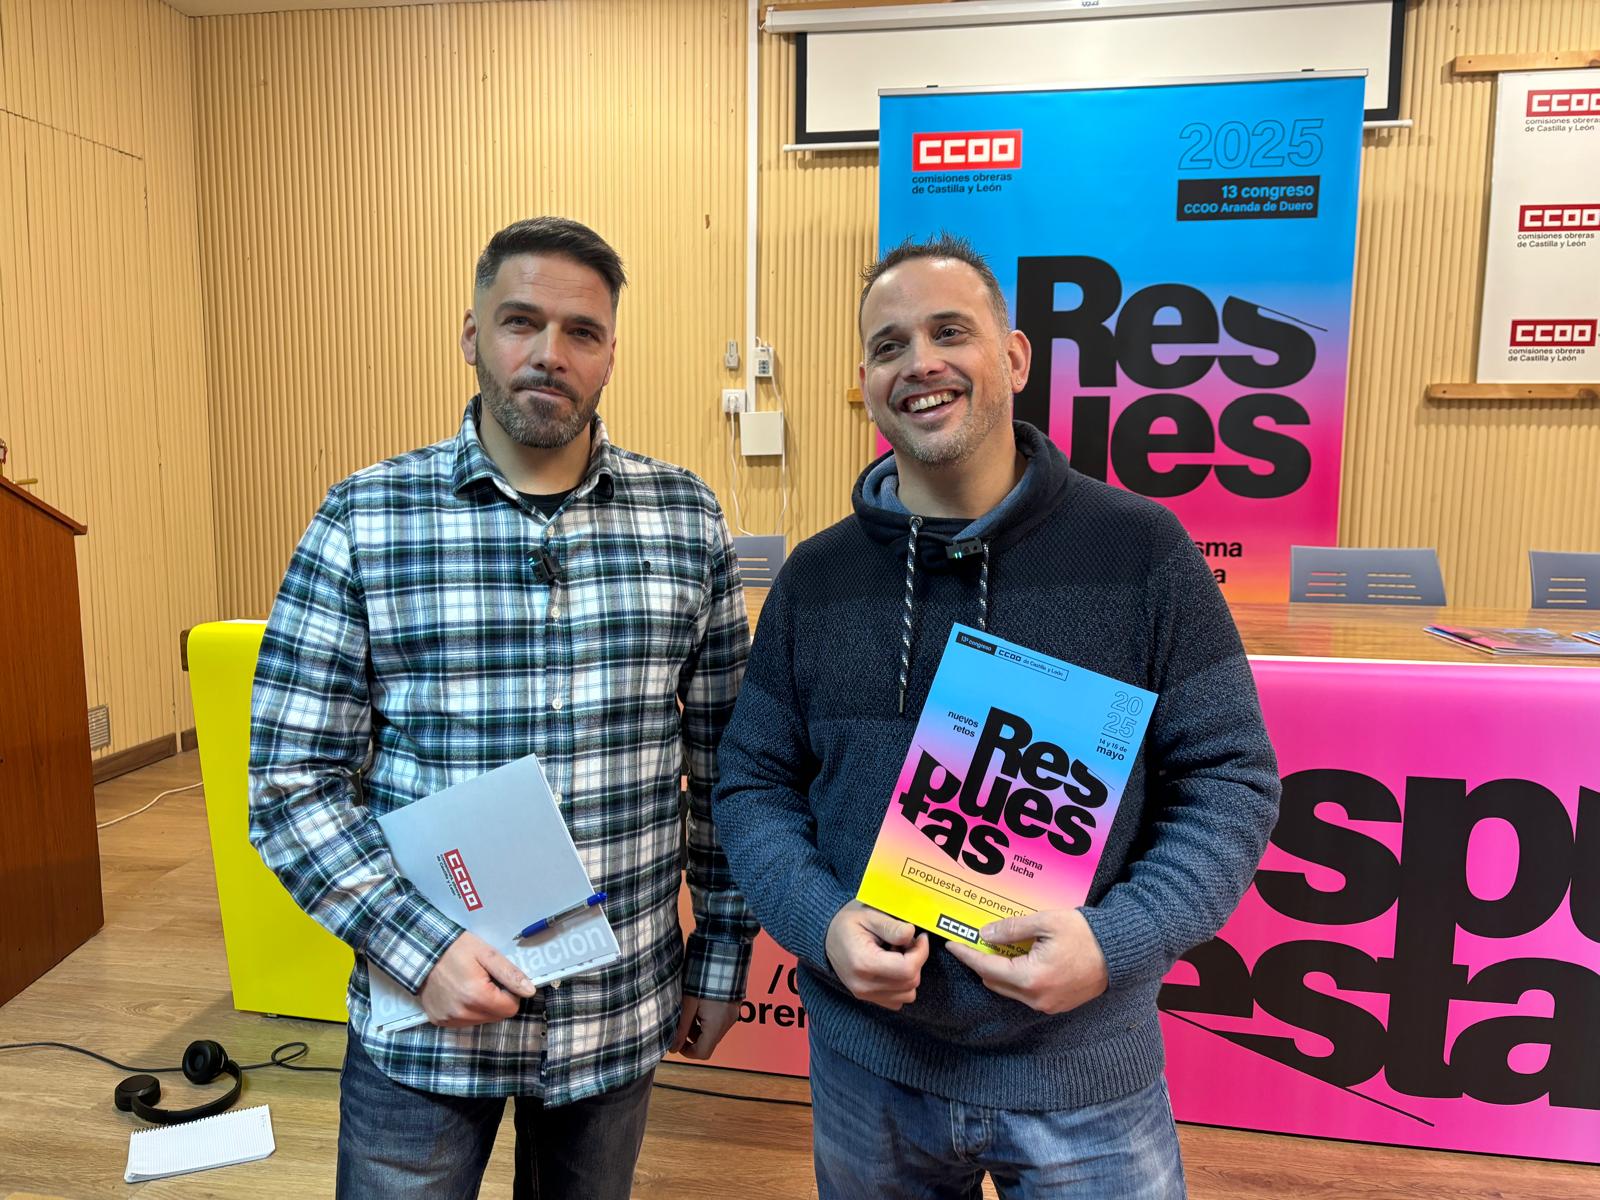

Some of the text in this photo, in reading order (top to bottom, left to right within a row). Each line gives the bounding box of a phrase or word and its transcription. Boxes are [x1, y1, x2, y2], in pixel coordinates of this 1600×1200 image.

[919, 138, 1015, 164] CCOO
[1177, 118, 1324, 170] 2025
[912, 173, 1013, 184] comisiones obreras
[911, 183, 1002, 195] de Castilla y León
[1221, 184, 1315, 200] 13 congreso
[1184, 200, 1313, 214] CCOO Aranda de Duero
[1524, 208, 1600, 227] CCOO
[1515, 324, 1592, 342] CCOO
[998, 649, 1022, 662] CCOO
[1111, 690, 1144, 716] 20
[947, 710, 979, 728] nuevos
[1102, 711, 1137, 738] 25
[953, 724, 976, 738] retos
[1096, 745, 1125, 760] mayo
[1120, 745, 1128, 753] de
[1010, 861, 1035, 878] lucha
[1013, 853, 1043, 871] misma
[447, 853, 479, 907] CCOO
[907, 866, 1027, 918] propuesta de ponenci
[939, 916, 978, 941] CCOO
